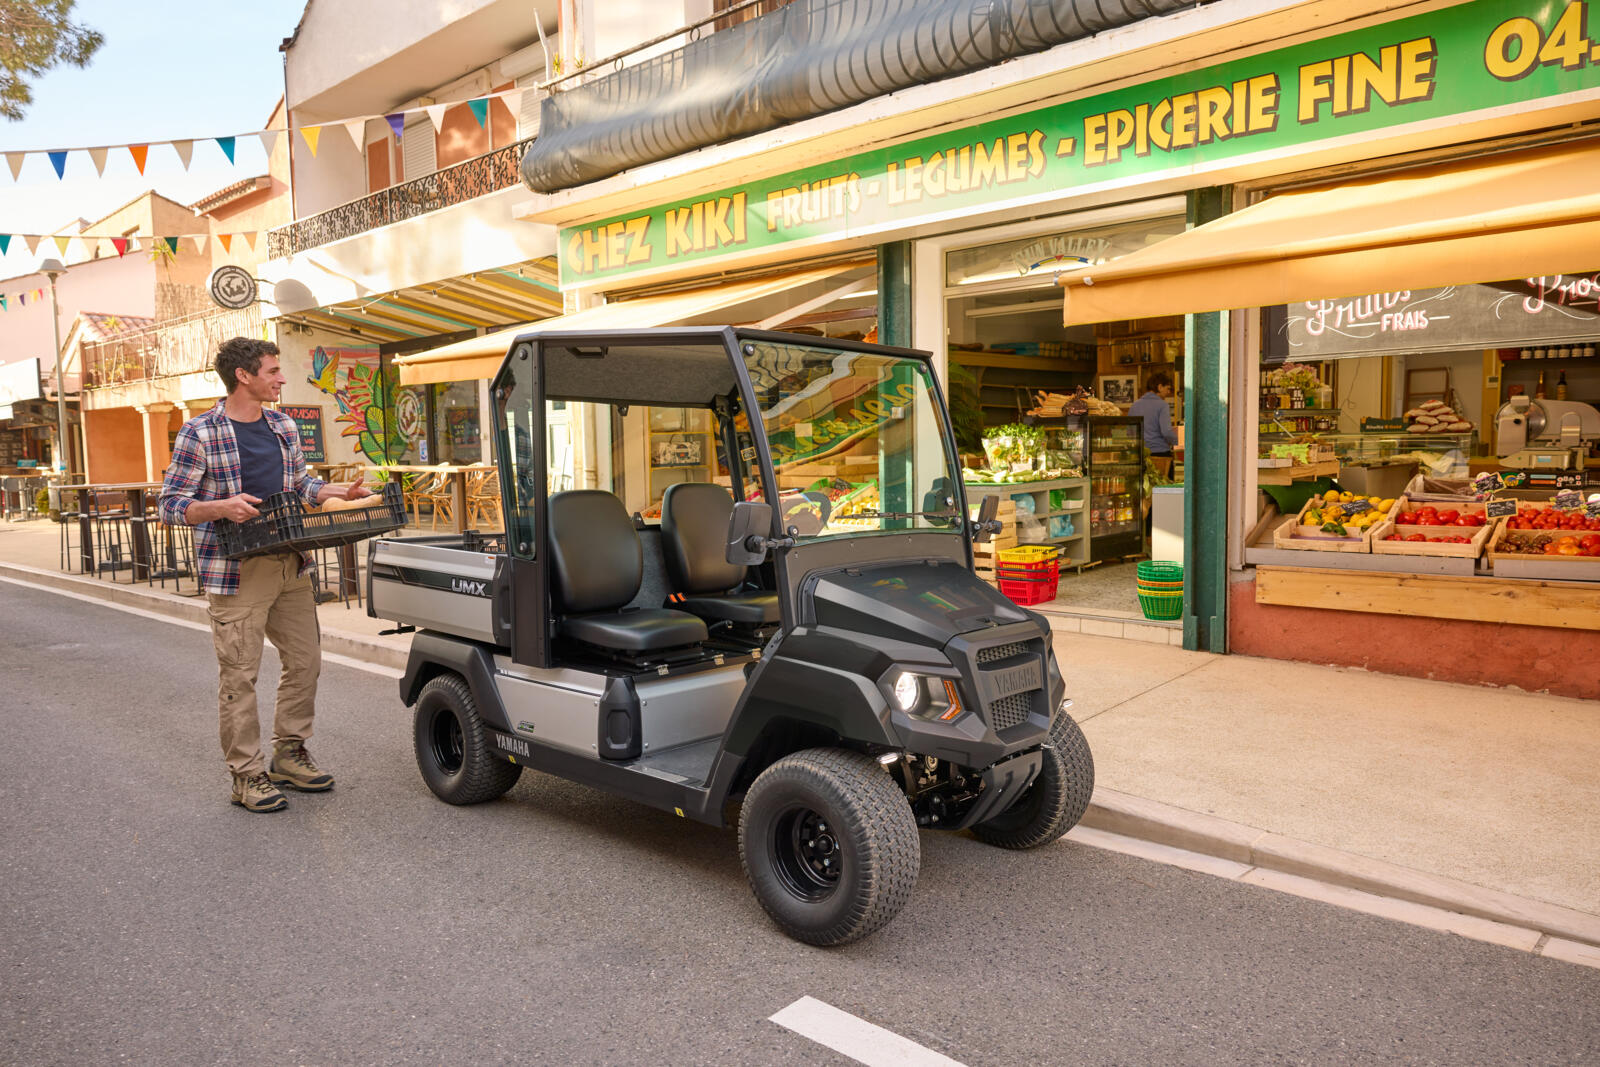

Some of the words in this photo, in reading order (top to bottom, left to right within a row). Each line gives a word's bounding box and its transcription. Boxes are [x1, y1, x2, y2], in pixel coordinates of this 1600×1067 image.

[567, 215, 652, 275] CHEZ
[665, 191, 748, 258] KIKI
[766, 172, 861, 233] FRUITS
[887, 129, 1048, 206] LEGUMES
[1083, 72, 1282, 169] EPICERIE
[1297, 35, 1439, 125] FINE
[1049, 236, 1111, 266] VALLEY
[1381, 309, 1429, 332] FRAIS
[279, 407, 320, 420] IVRAISON
[451, 578, 487, 597] UMX
[496, 733, 531, 758] YAMAHA
